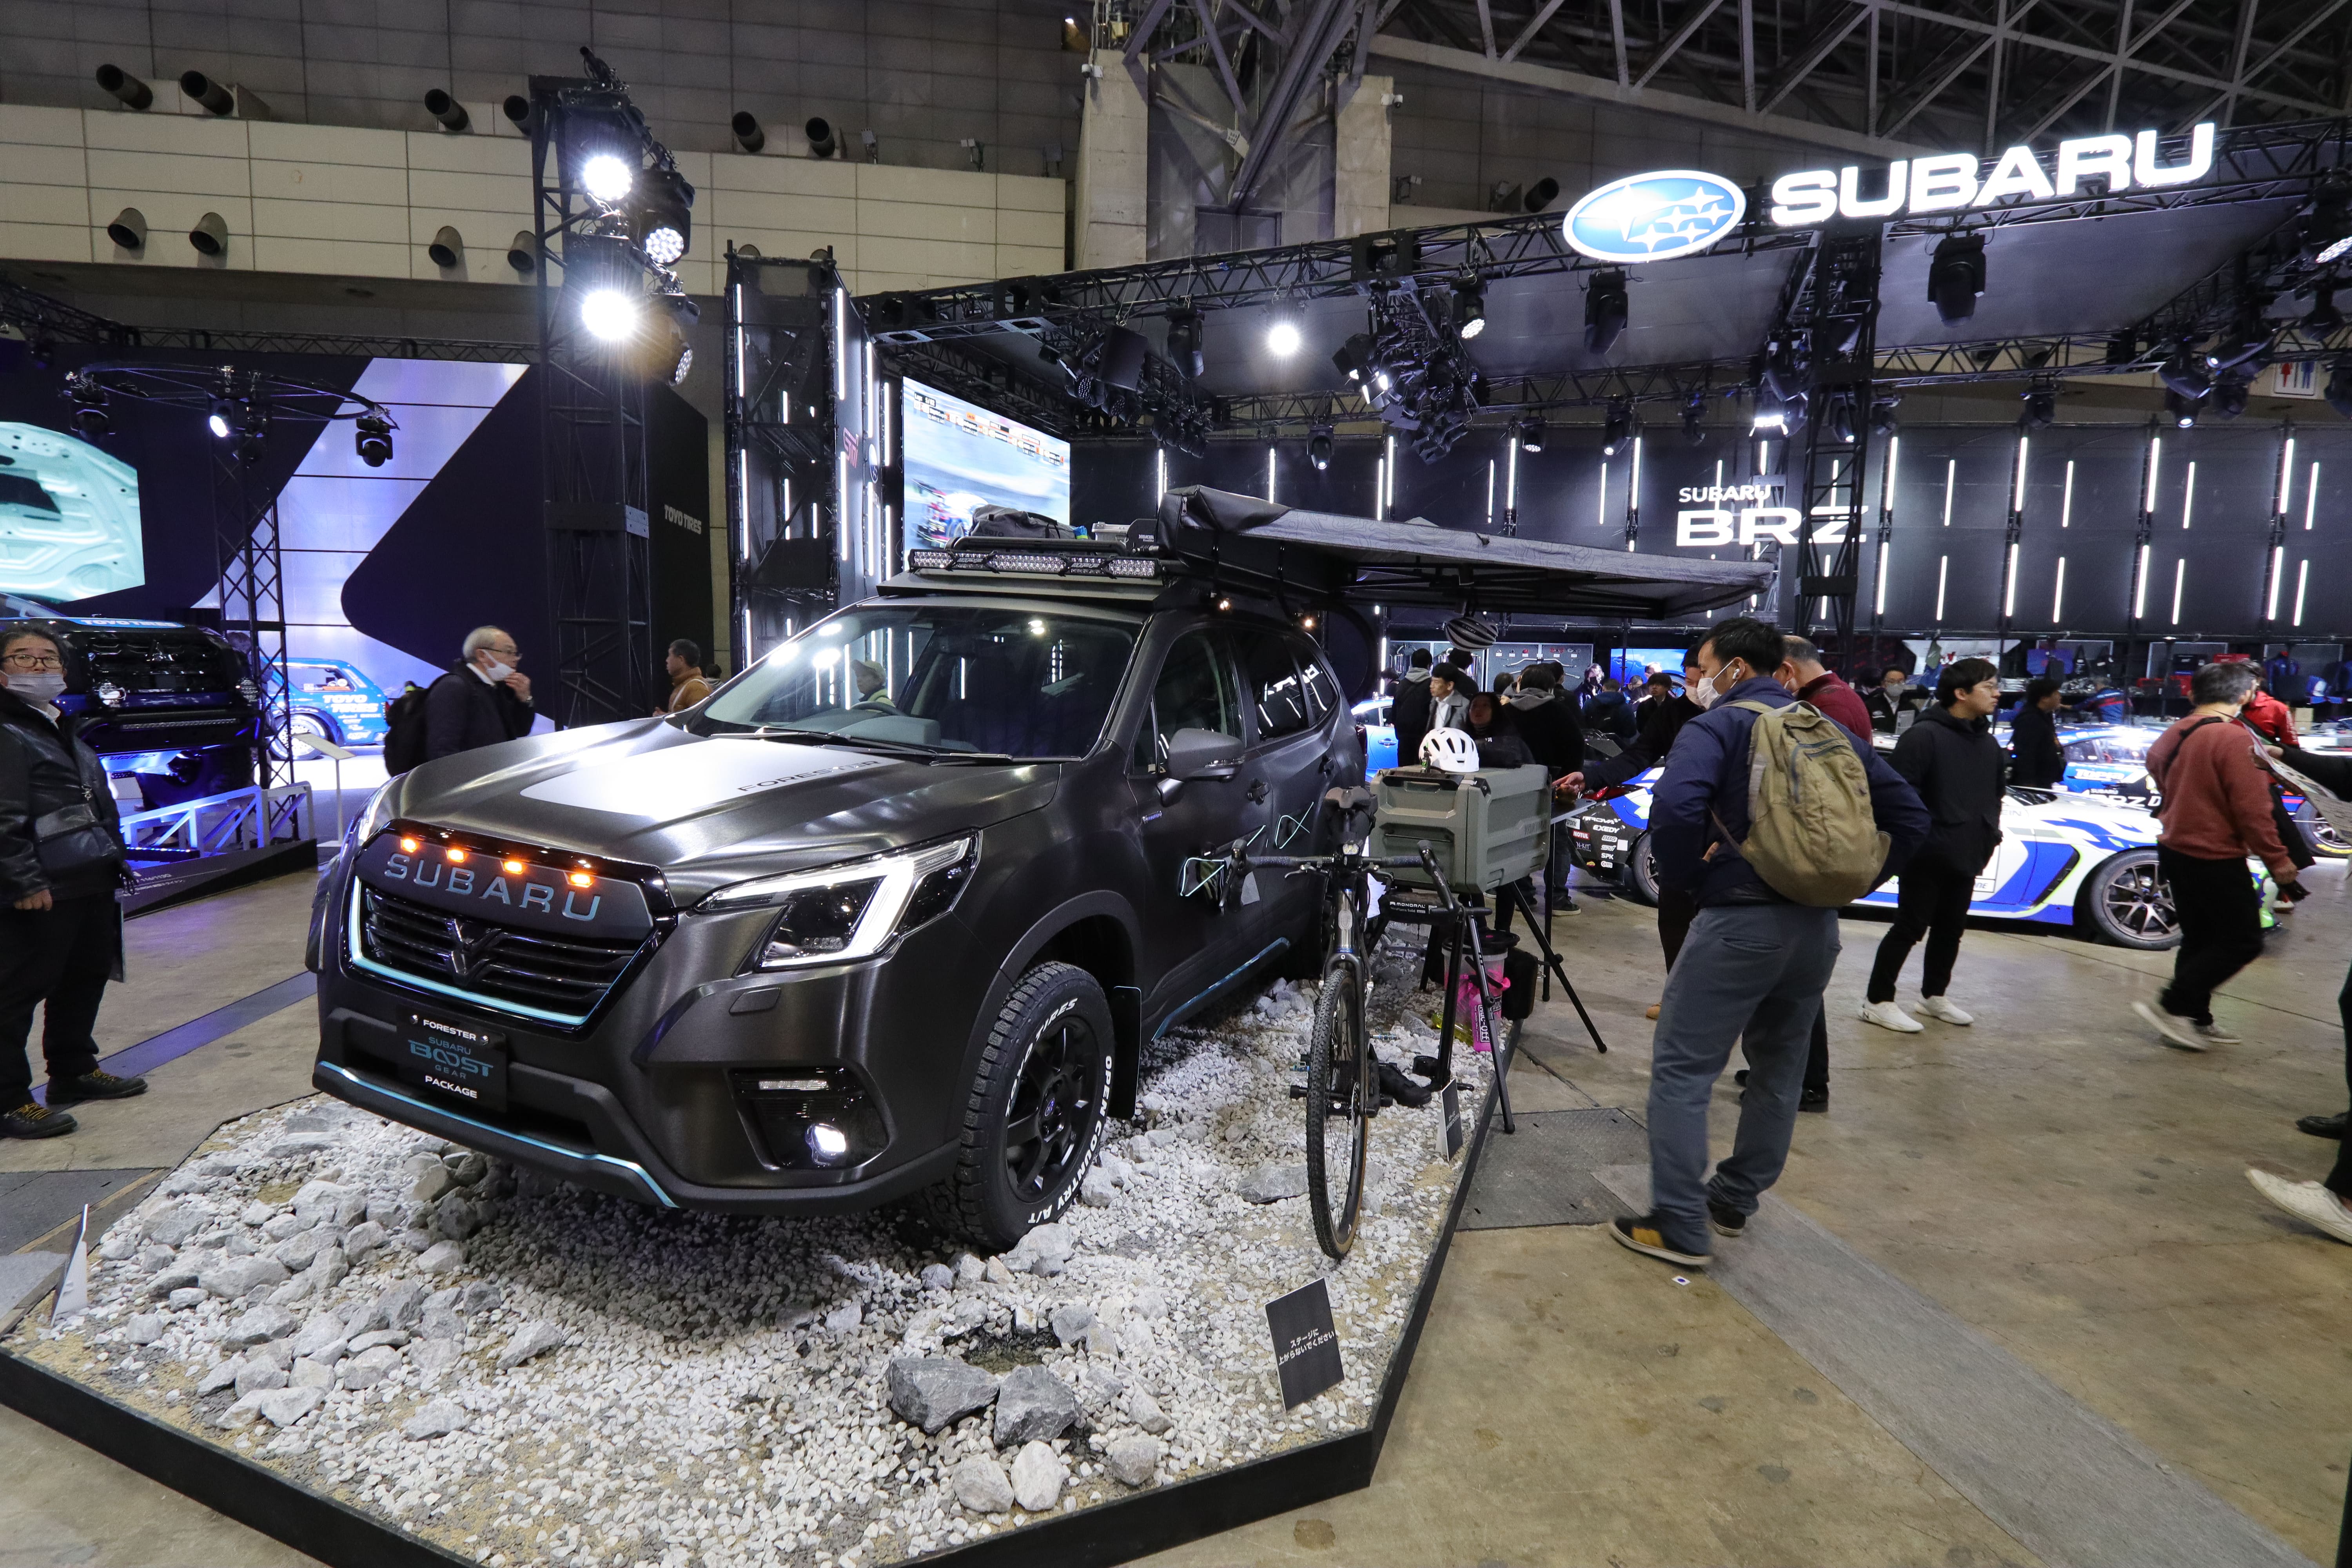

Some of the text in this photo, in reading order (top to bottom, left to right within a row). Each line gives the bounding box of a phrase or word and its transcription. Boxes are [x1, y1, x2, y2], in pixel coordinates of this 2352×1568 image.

[1771, 122, 2215, 227] SUBARU
[1679, 484, 1771, 503] SUBARU
[664, 504, 702, 534] TOYO TIRES
[323, 695, 368, 703] TOYO
[330, 703, 379, 713] TIRES
[1593, 824, 1620, 833] EXEDY
[384, 853, 601, 921] SUBARU
[423, 1019, 476, 1041] FORESTER
[428, 1036, 471, 1055] SUBARU
[1005, 998, 1078, 1117] TOYO TIRES
[435, 1065, 466, 1079] GEAR
[425, 1075, 477, 1098] PACKAGE
[1028, 1056, 1112, 1223] OPEN COUNTRY A/T
[1279, 1330, 1334, 1366] 上がらないでください
[1290, 1328, 1319, 1348] ステージに
